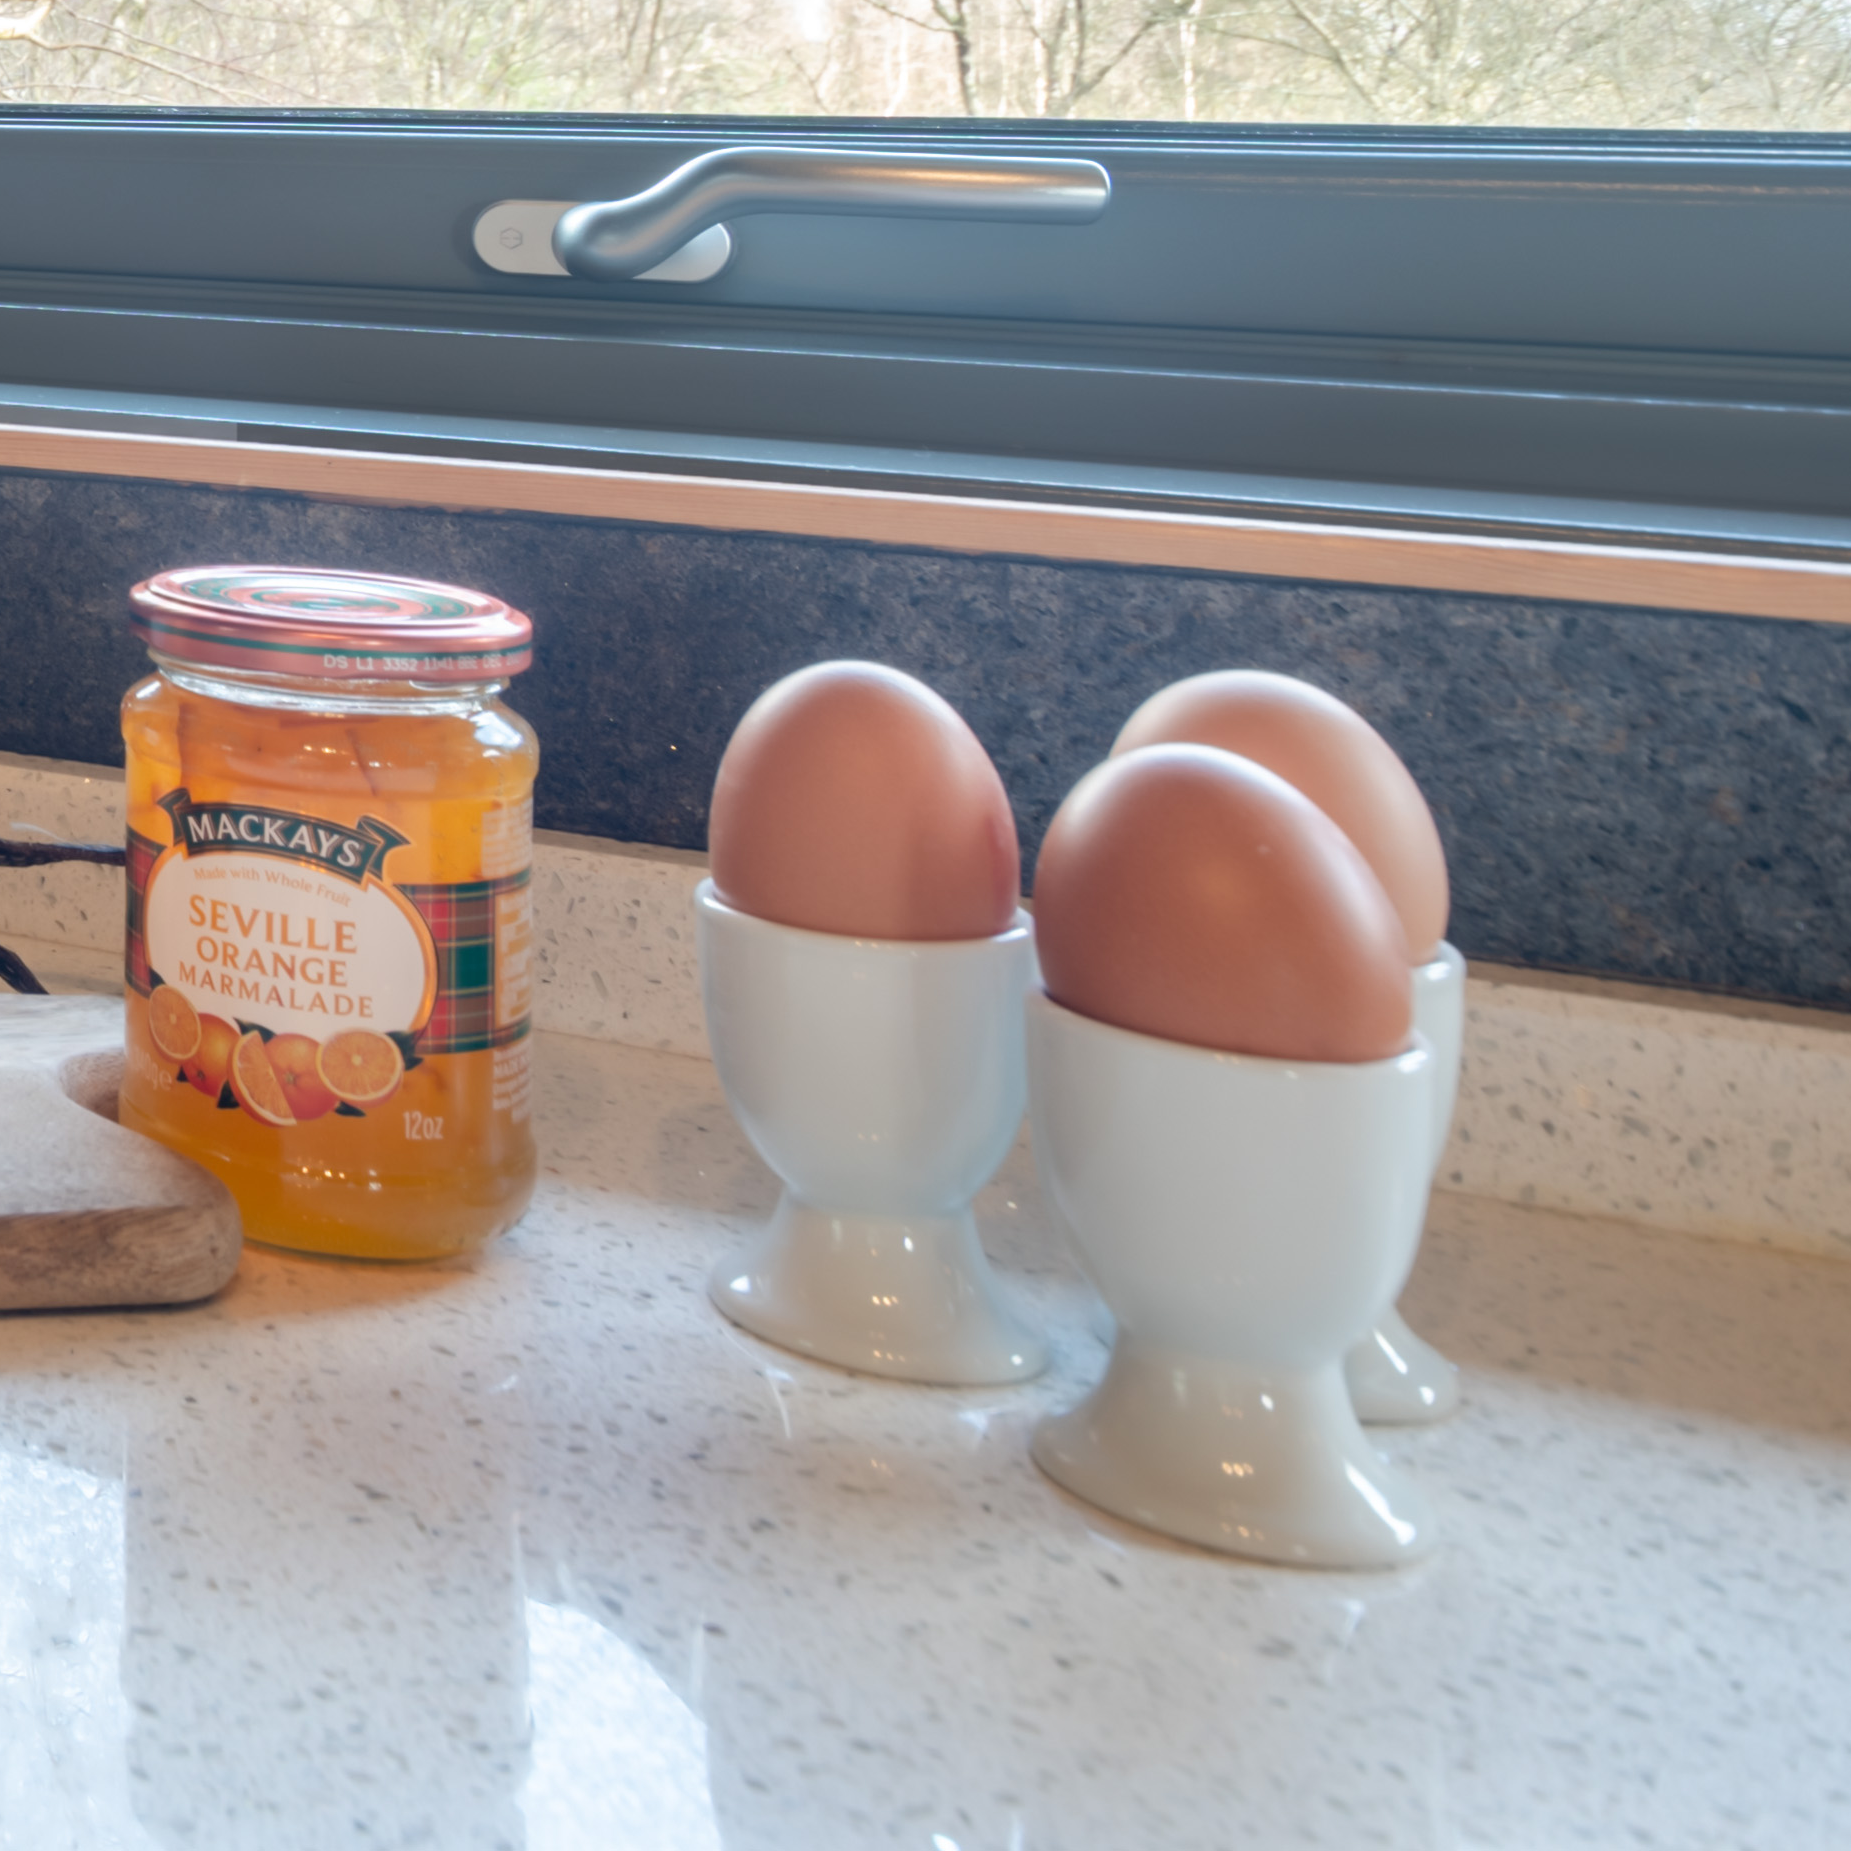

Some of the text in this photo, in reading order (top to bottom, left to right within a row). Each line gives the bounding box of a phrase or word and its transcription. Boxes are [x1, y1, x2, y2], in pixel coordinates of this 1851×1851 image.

[323, 653, 349, 670] DS
[383, 656, 418, 673] 3352
[186, 812, 361, 867] MACKAYS
[193, 866, 352, 908] Made with Whole Fruit
[188, 894, 358, 954] SEVILLE
[195, 936, 347, 988] ORANGE
[178, 960, 374, 1019] MARMALADE
[402, 1110, 445, 1141] 12oz
